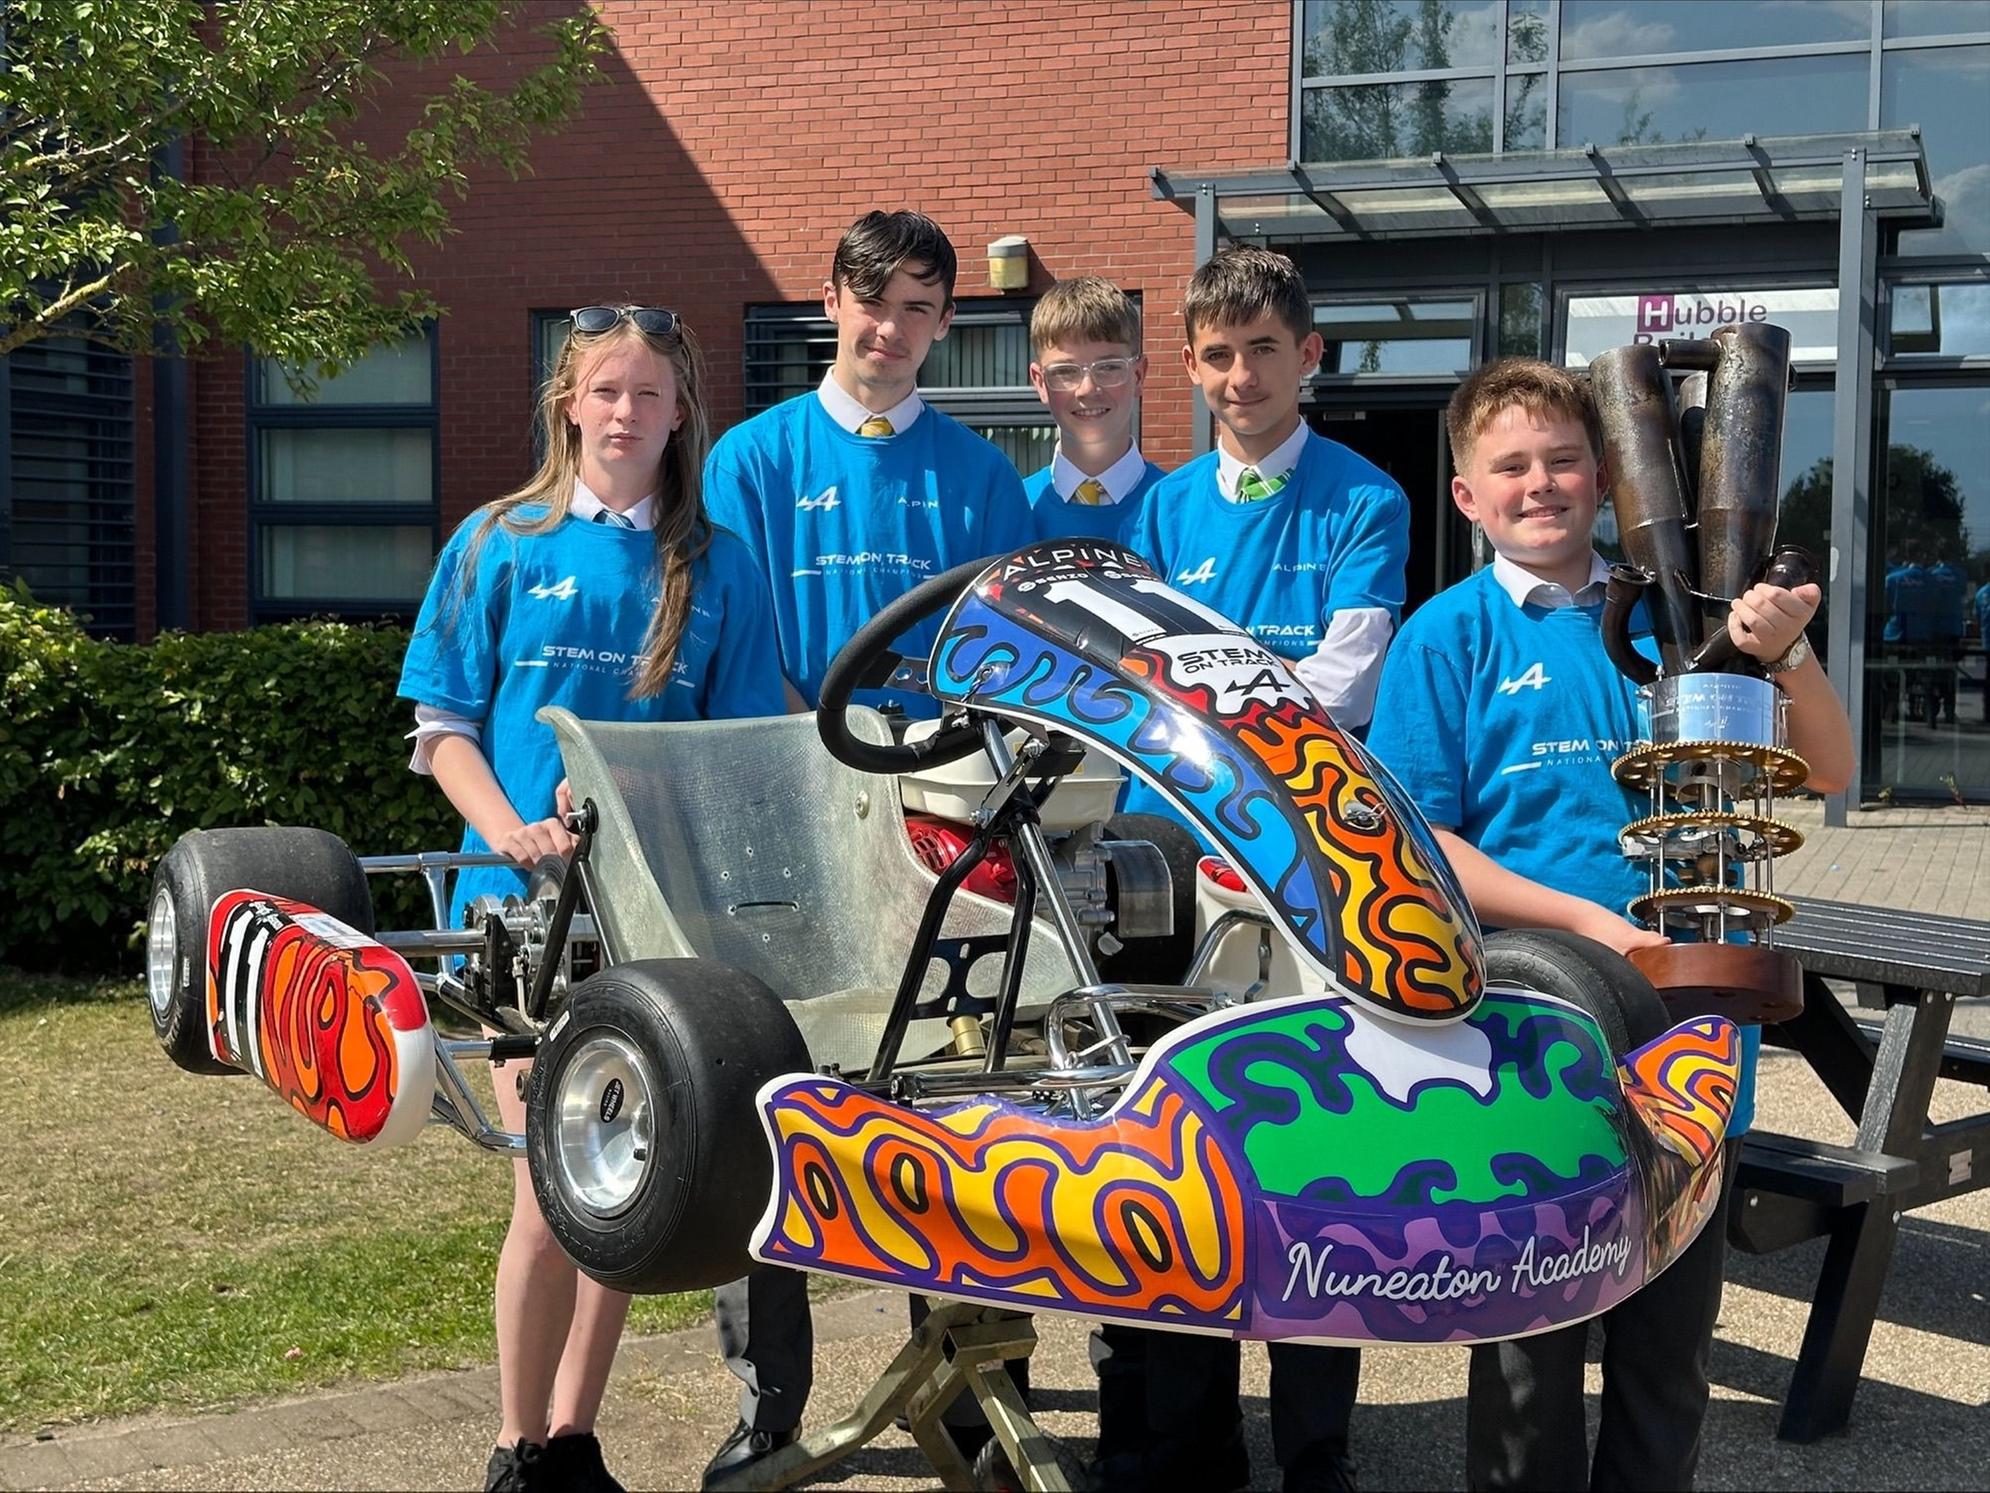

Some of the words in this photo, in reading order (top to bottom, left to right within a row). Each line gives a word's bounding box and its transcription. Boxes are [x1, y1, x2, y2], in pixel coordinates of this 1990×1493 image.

[1643, 299, 1767, 328] Hubble
[816, 555, 860, 566] STEM
[861, 552, 882, 564] ON
[1003, 548, 1142, 581] ALPINE
[1273, 562, 1327, 573] ALPINE
[1257, 624, 1316, 636] TRACK
[542, 645, 594, 661] STEM
[598, 651, 626, 664] ON
[1177, 648, 1273, 667] STEM
[553, 661, 607, 674] NATIONAL
[1184, 661, 1214, 674] ON
[1217, 658, 1281, 668] TRACK
[1532, 739, 1590, 756] STEM
[1595, 740, 1619, 752] ON
[1546, 756, 1601, 767] NATIONA
[1281, 1241, 1501, 1302] Nuneaton
[1511, 1225, 1632, 1293] Academy
